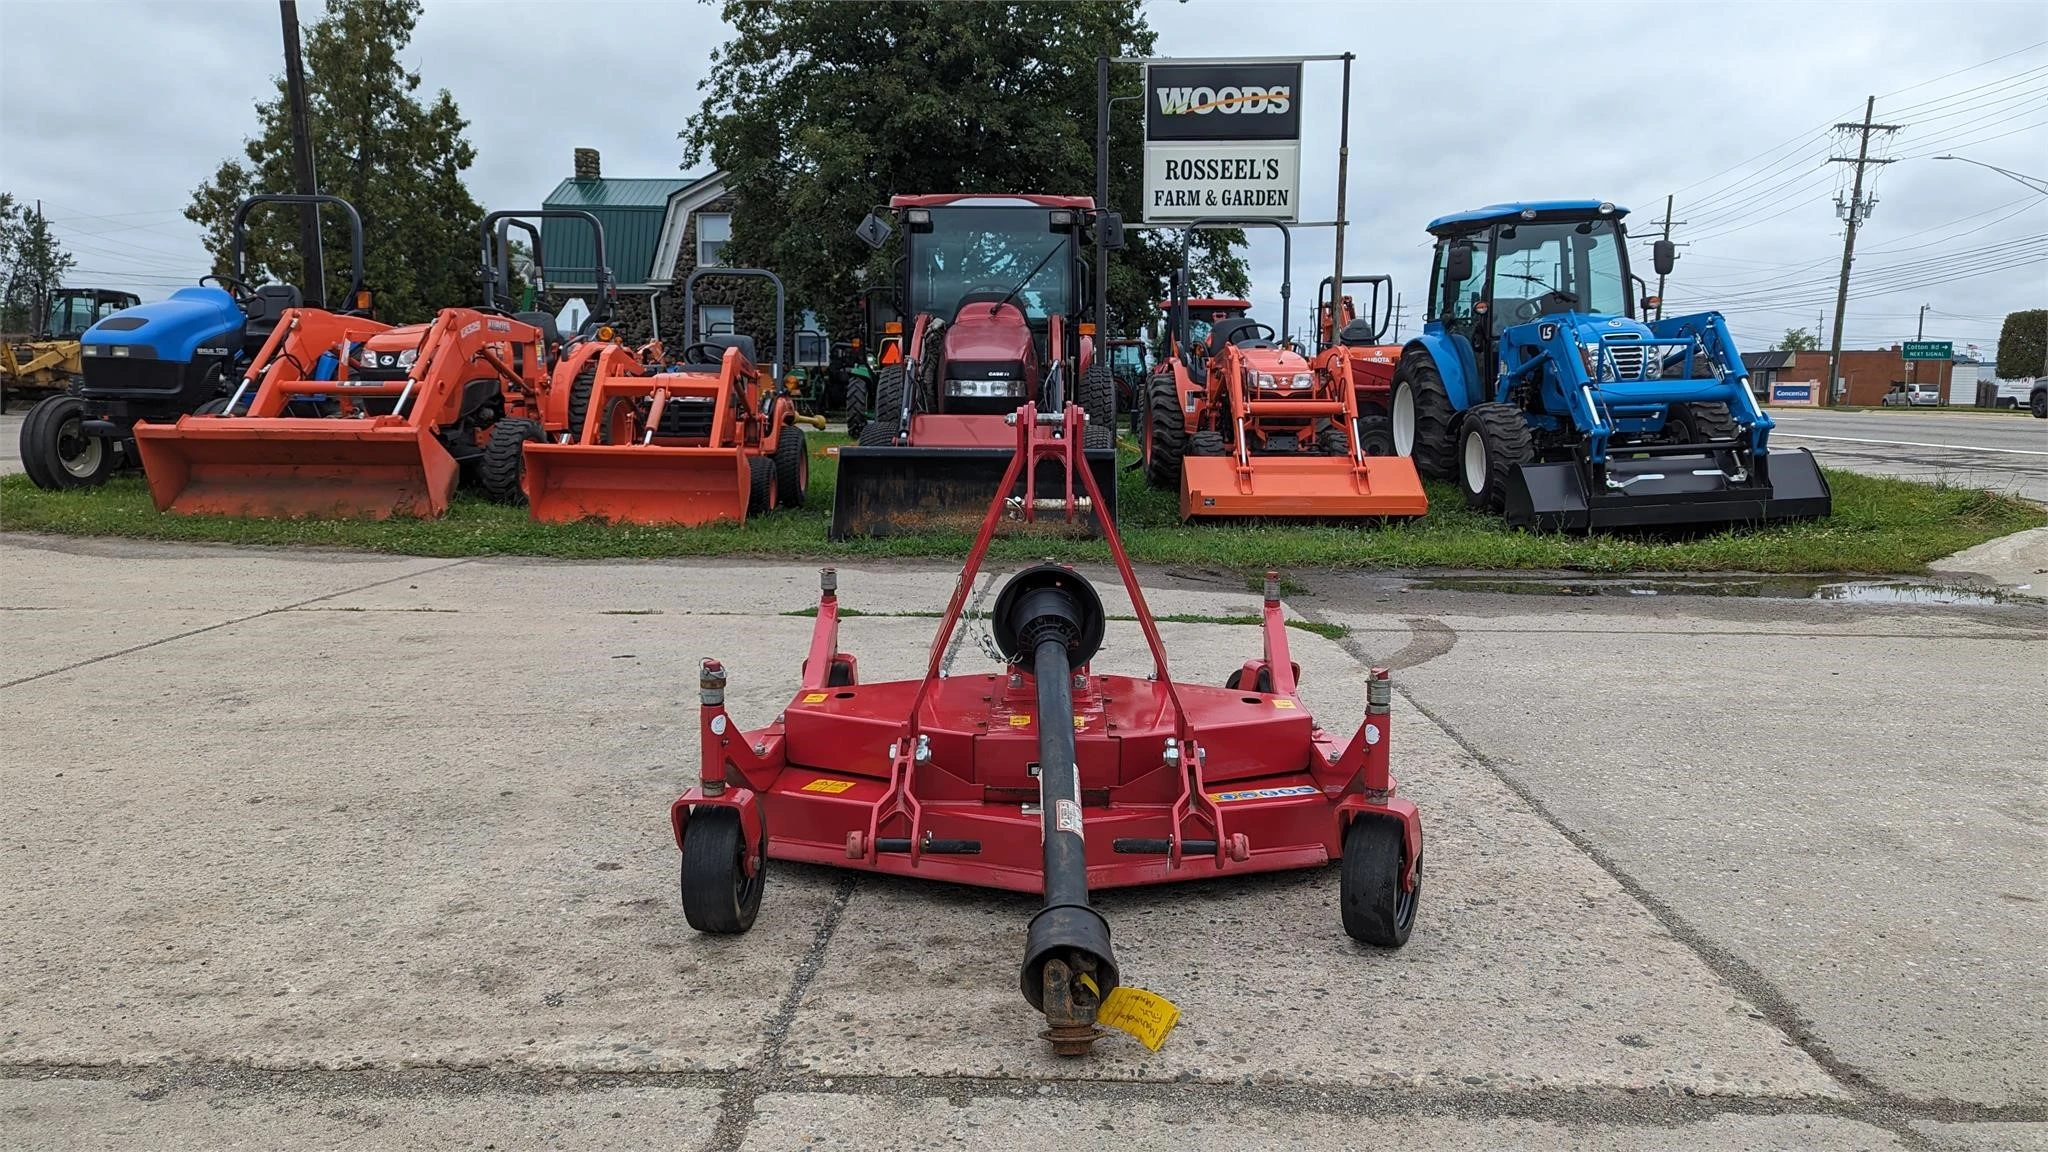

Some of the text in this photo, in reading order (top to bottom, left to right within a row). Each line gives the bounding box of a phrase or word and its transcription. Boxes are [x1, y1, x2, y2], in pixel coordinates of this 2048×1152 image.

[1156, 86, 1290, 115] WOODS
[1165, 158, 1279, 180] ROSSEEL'S
[1154, 189, 1289, 206] FARM & GARDEN
[1542, 327, 1552, 339] LS
